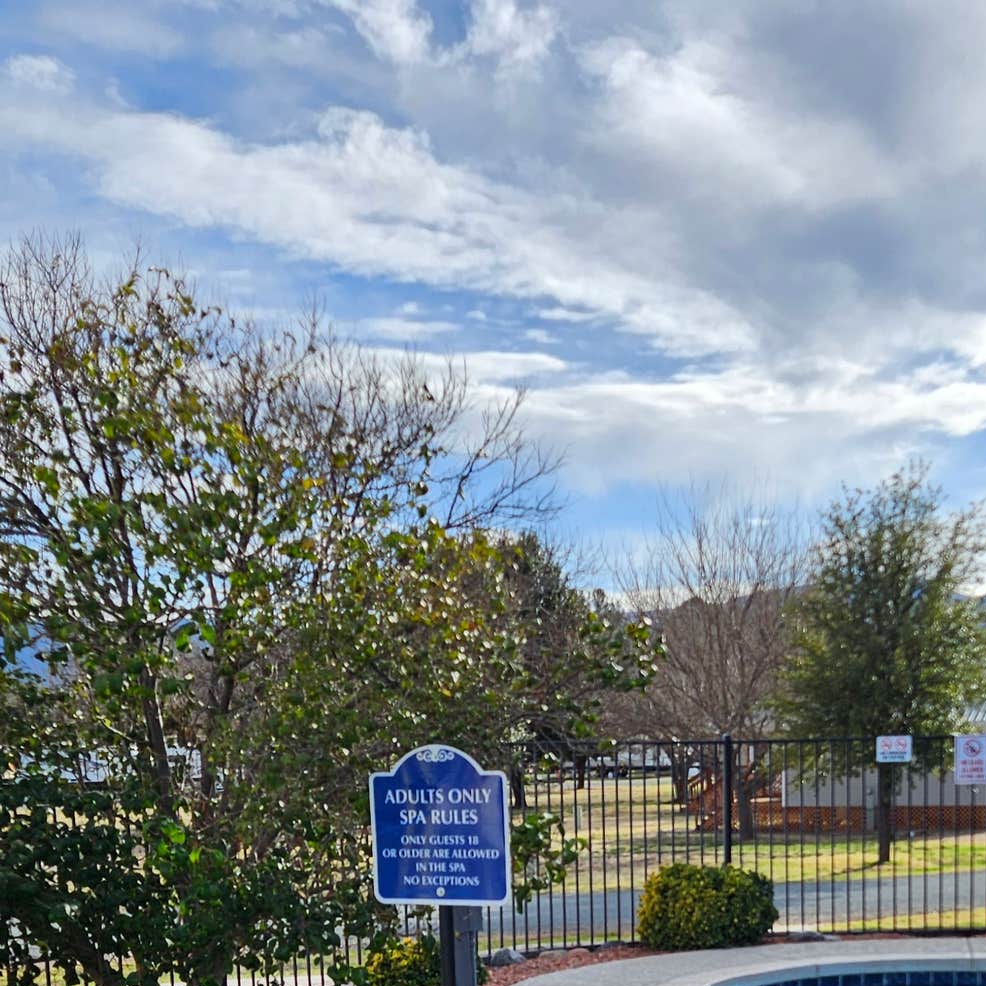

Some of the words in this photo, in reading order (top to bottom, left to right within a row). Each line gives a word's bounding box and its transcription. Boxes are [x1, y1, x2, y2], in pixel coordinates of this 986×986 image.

[385, 788, 444, 804] ADULTS
[448, 788, 491, 804] ONLY
[400, 810, 427, 825] SPA
[431, 809, 478, 825] RULES
[400, 835, 426, 846] ONLY
[429, 835, 465, 845] GUESTS
[468, 835, 479, 845] 18
[382, 849, 398, 859] OR
[399, 849, 431, 860] OLDER
[432, 849, 451, 859] ARE
[451, 848, 500, 860] ALLOWED
[415, 863, 428, 873] IN
[429, 862, 447, 873] THE
[449, 862, 466, 873] SPA
[403, 876, 420, 886] NO
[421, 876, 480, 887] EXCEPTIONS
